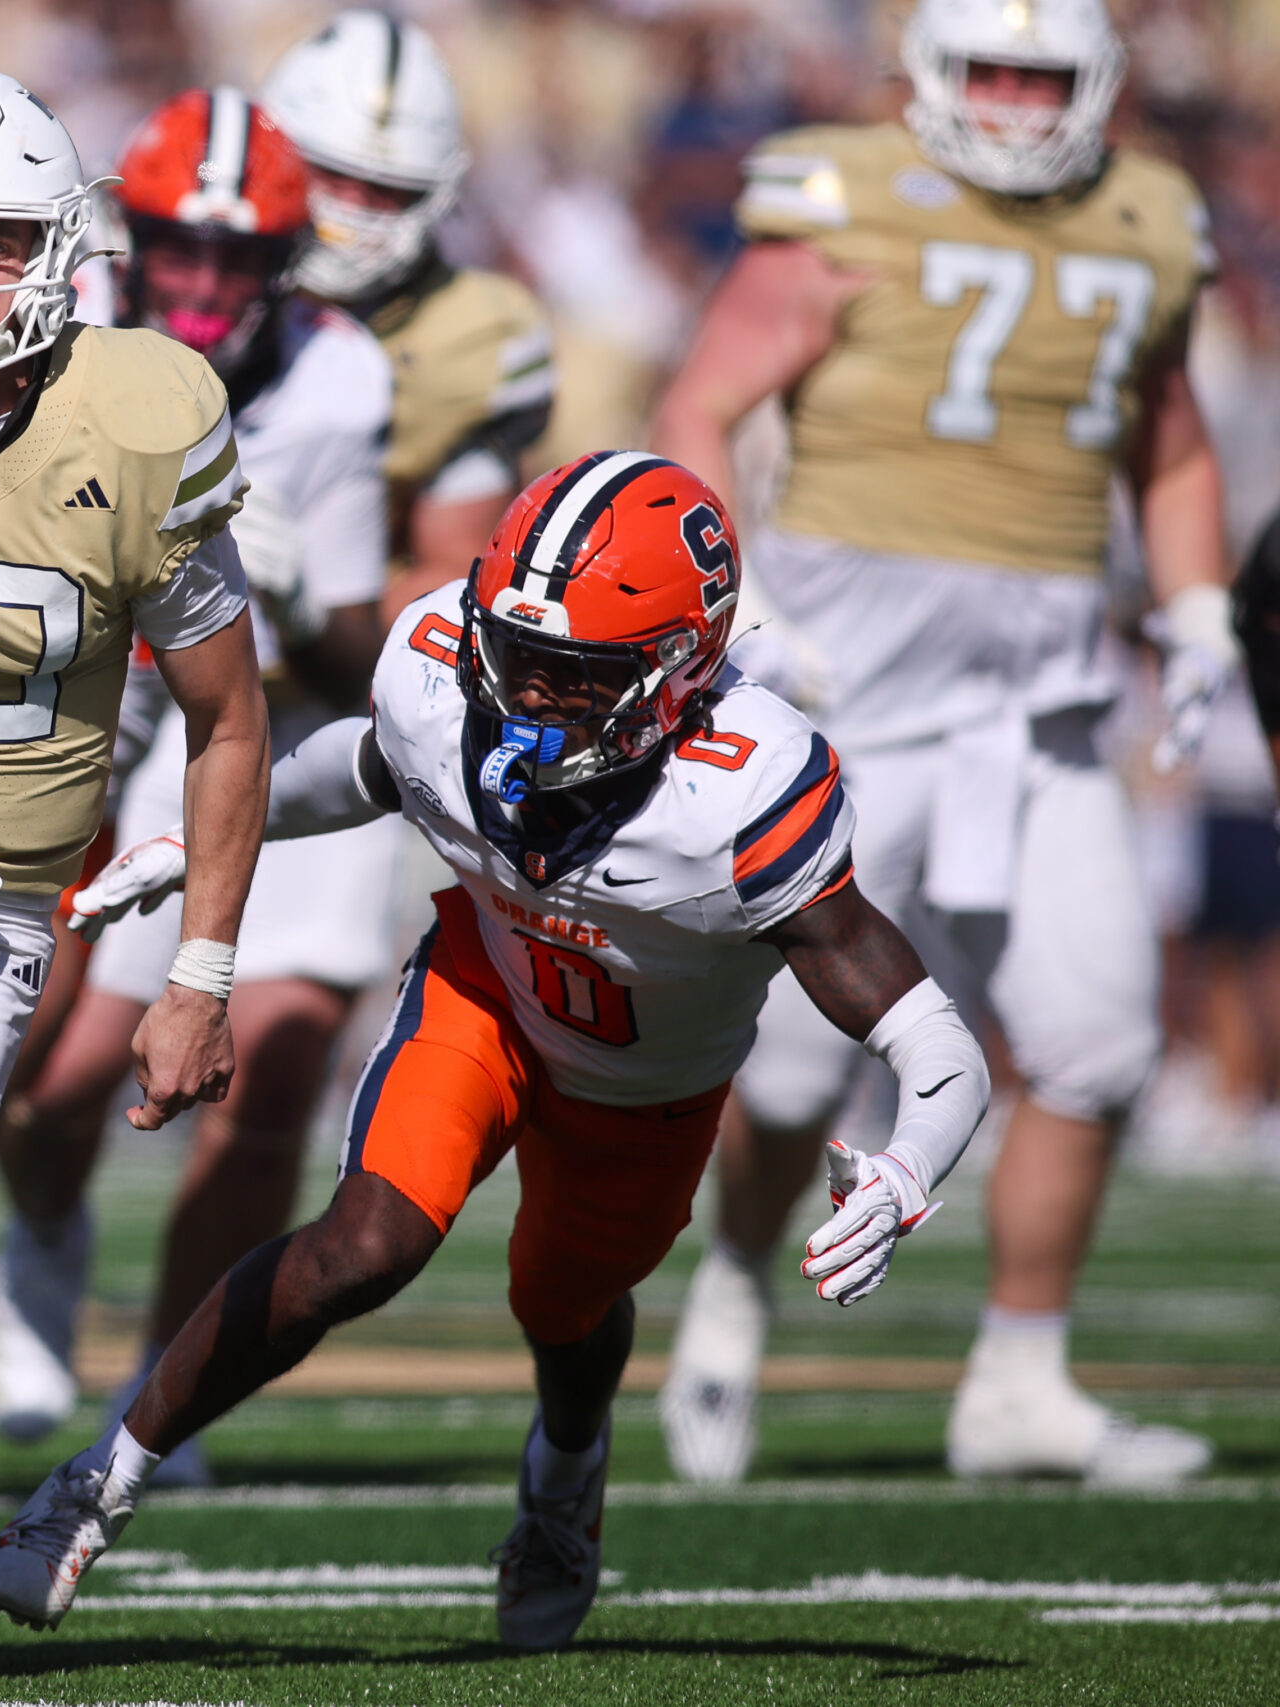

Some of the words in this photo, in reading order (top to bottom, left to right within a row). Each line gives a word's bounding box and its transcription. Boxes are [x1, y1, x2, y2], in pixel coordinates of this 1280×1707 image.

[921, 242, 1156, 447] 77
[680, 501, 738, 612] S
[509, 601, 549, 620] ACC
[674, 725, 759, 772] 0
[490, 892, 610, 949] ORANGE
